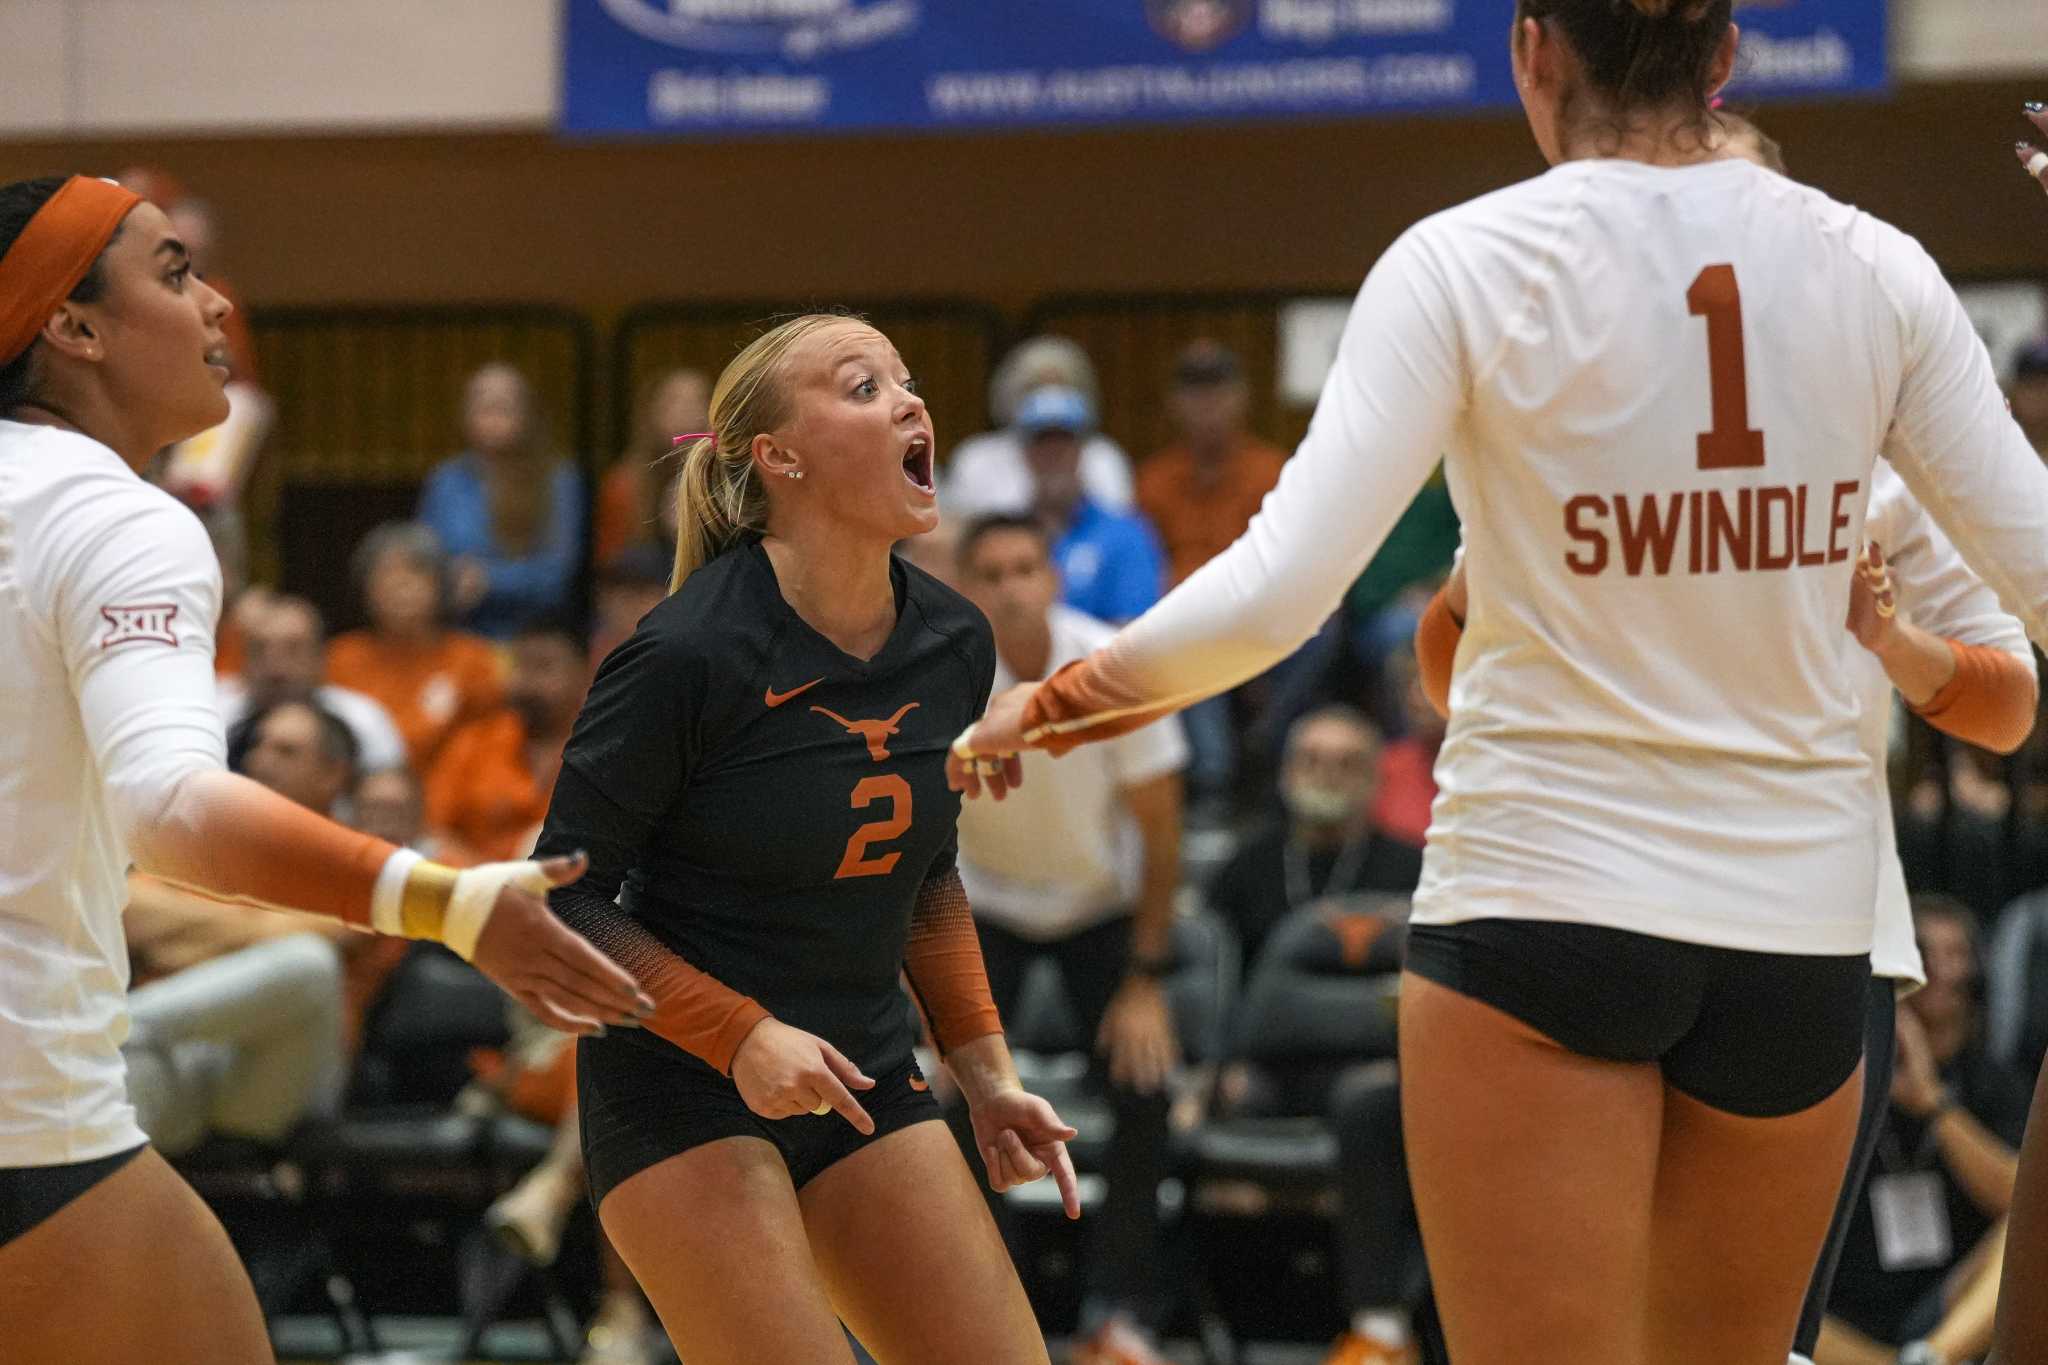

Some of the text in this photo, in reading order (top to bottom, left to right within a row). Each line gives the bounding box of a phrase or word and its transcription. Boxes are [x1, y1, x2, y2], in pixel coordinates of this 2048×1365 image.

[1686, 263, 1765, 470] 1
[1563, 480, 1860, 577] SWINDLE
[101, 604, 177, 648] XII
[833, 773, 912, 879] 2
